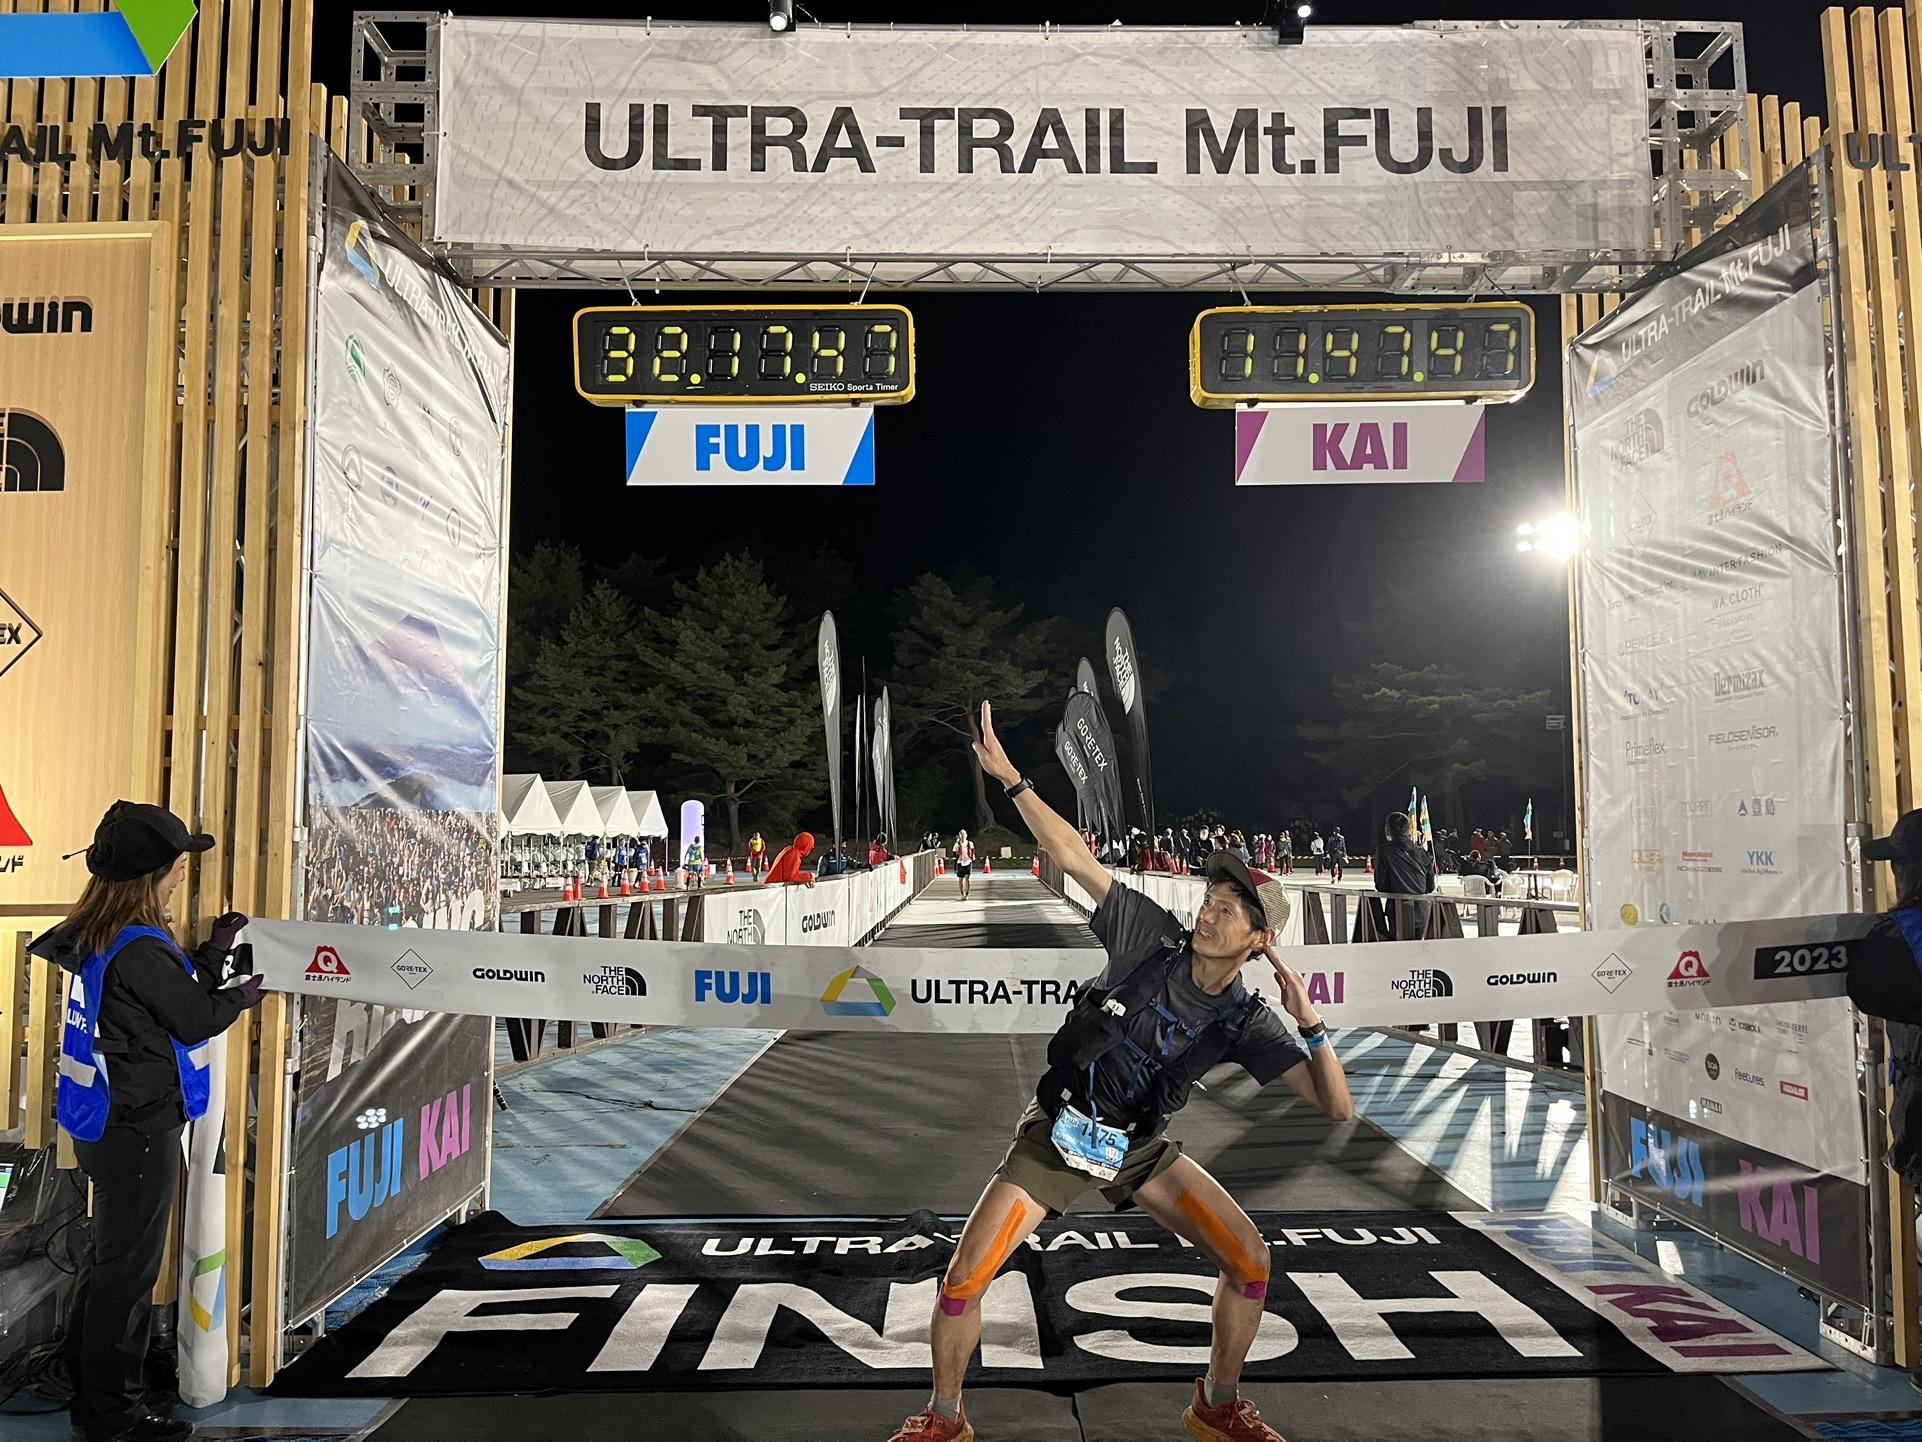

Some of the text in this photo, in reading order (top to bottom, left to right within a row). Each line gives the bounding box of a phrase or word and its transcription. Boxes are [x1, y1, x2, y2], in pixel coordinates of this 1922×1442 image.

[92, 117, 291, 160] Mt.FUJI
[584, 102, 1508, 175] ULTRA-TRAIL Mt.FUJI
[1621, 223, 1792, 364] ULTRA-TRAIL Mt.FUJI
[810, 383, 899, 393] SEIKO Sports Timer
[1624, 409, 1645, 436] THE
[695, 423, 805, 472] FUJI
[1312, 422, 1408, 470] KAI
[1077, 717, 1108, 772] GORE-TEX
[1064, 741, 1088, 784] GORE-TEX
[1747, 850, 1774, 866] YKK
[739, 908, 753, 927] THE
[396, 965, 428, 973] GORE-TEX
[601, 965, 625, 975] THE
[1409, 969, 1432, 979] THE
[1596, 968, 1627, 977] GORE-TEX
[1773, 946, 1848, 975] 2023
[583, 974, 625, 985] NORTH
[595, 984, 625, 996] FACE
[694, 970, 771, 1005] FUJI
[1391, 979, 1432, 990] NORTH
[1402, 989, 1432, 999] FACE
[325, 1083, 471, 1239] FUJI KAI
[1630, 1116, 1821, 1264] FUJI KAI
[345, 1270, 1584, 1378] FINISH
[1584, 1282, 1792, 1358] KAI
